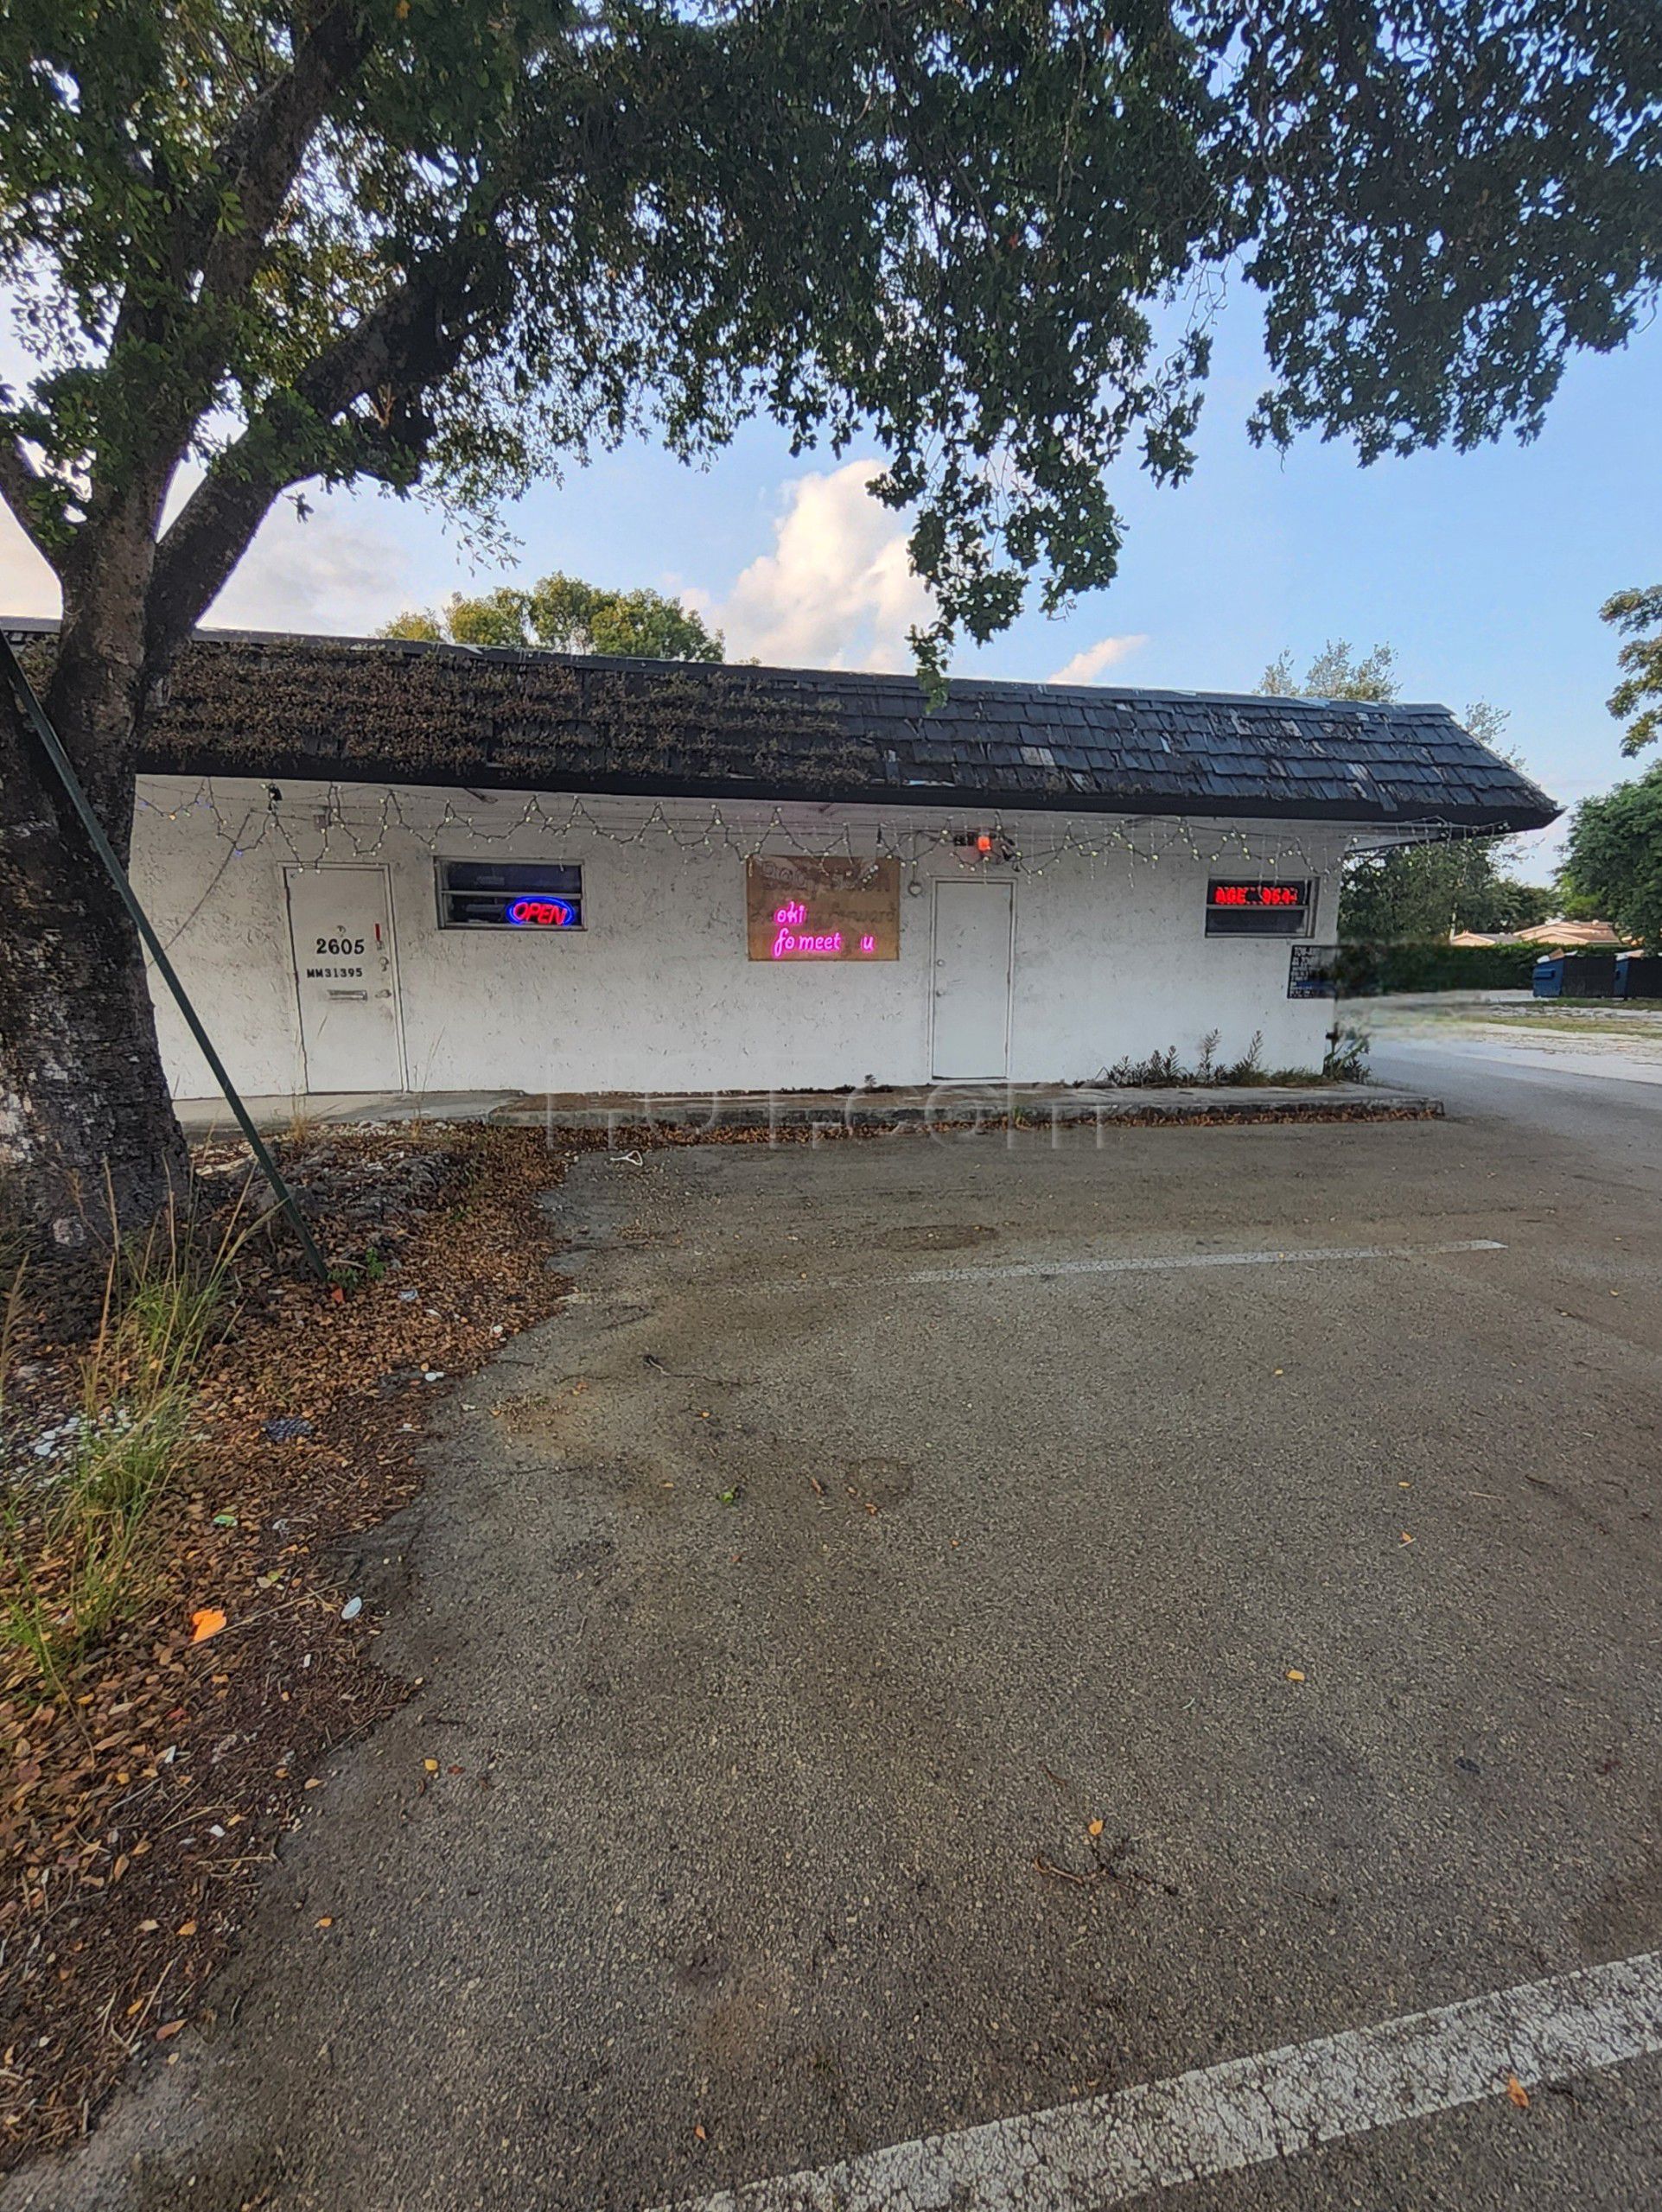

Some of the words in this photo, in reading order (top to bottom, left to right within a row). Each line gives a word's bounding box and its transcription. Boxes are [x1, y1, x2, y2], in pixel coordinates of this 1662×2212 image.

[513, 902, 568, 925] OPEN
[316, 938, 365, 955] 2605
[799, 932, 841, 950] meet
[307, 967, 363, 978] MM31395
